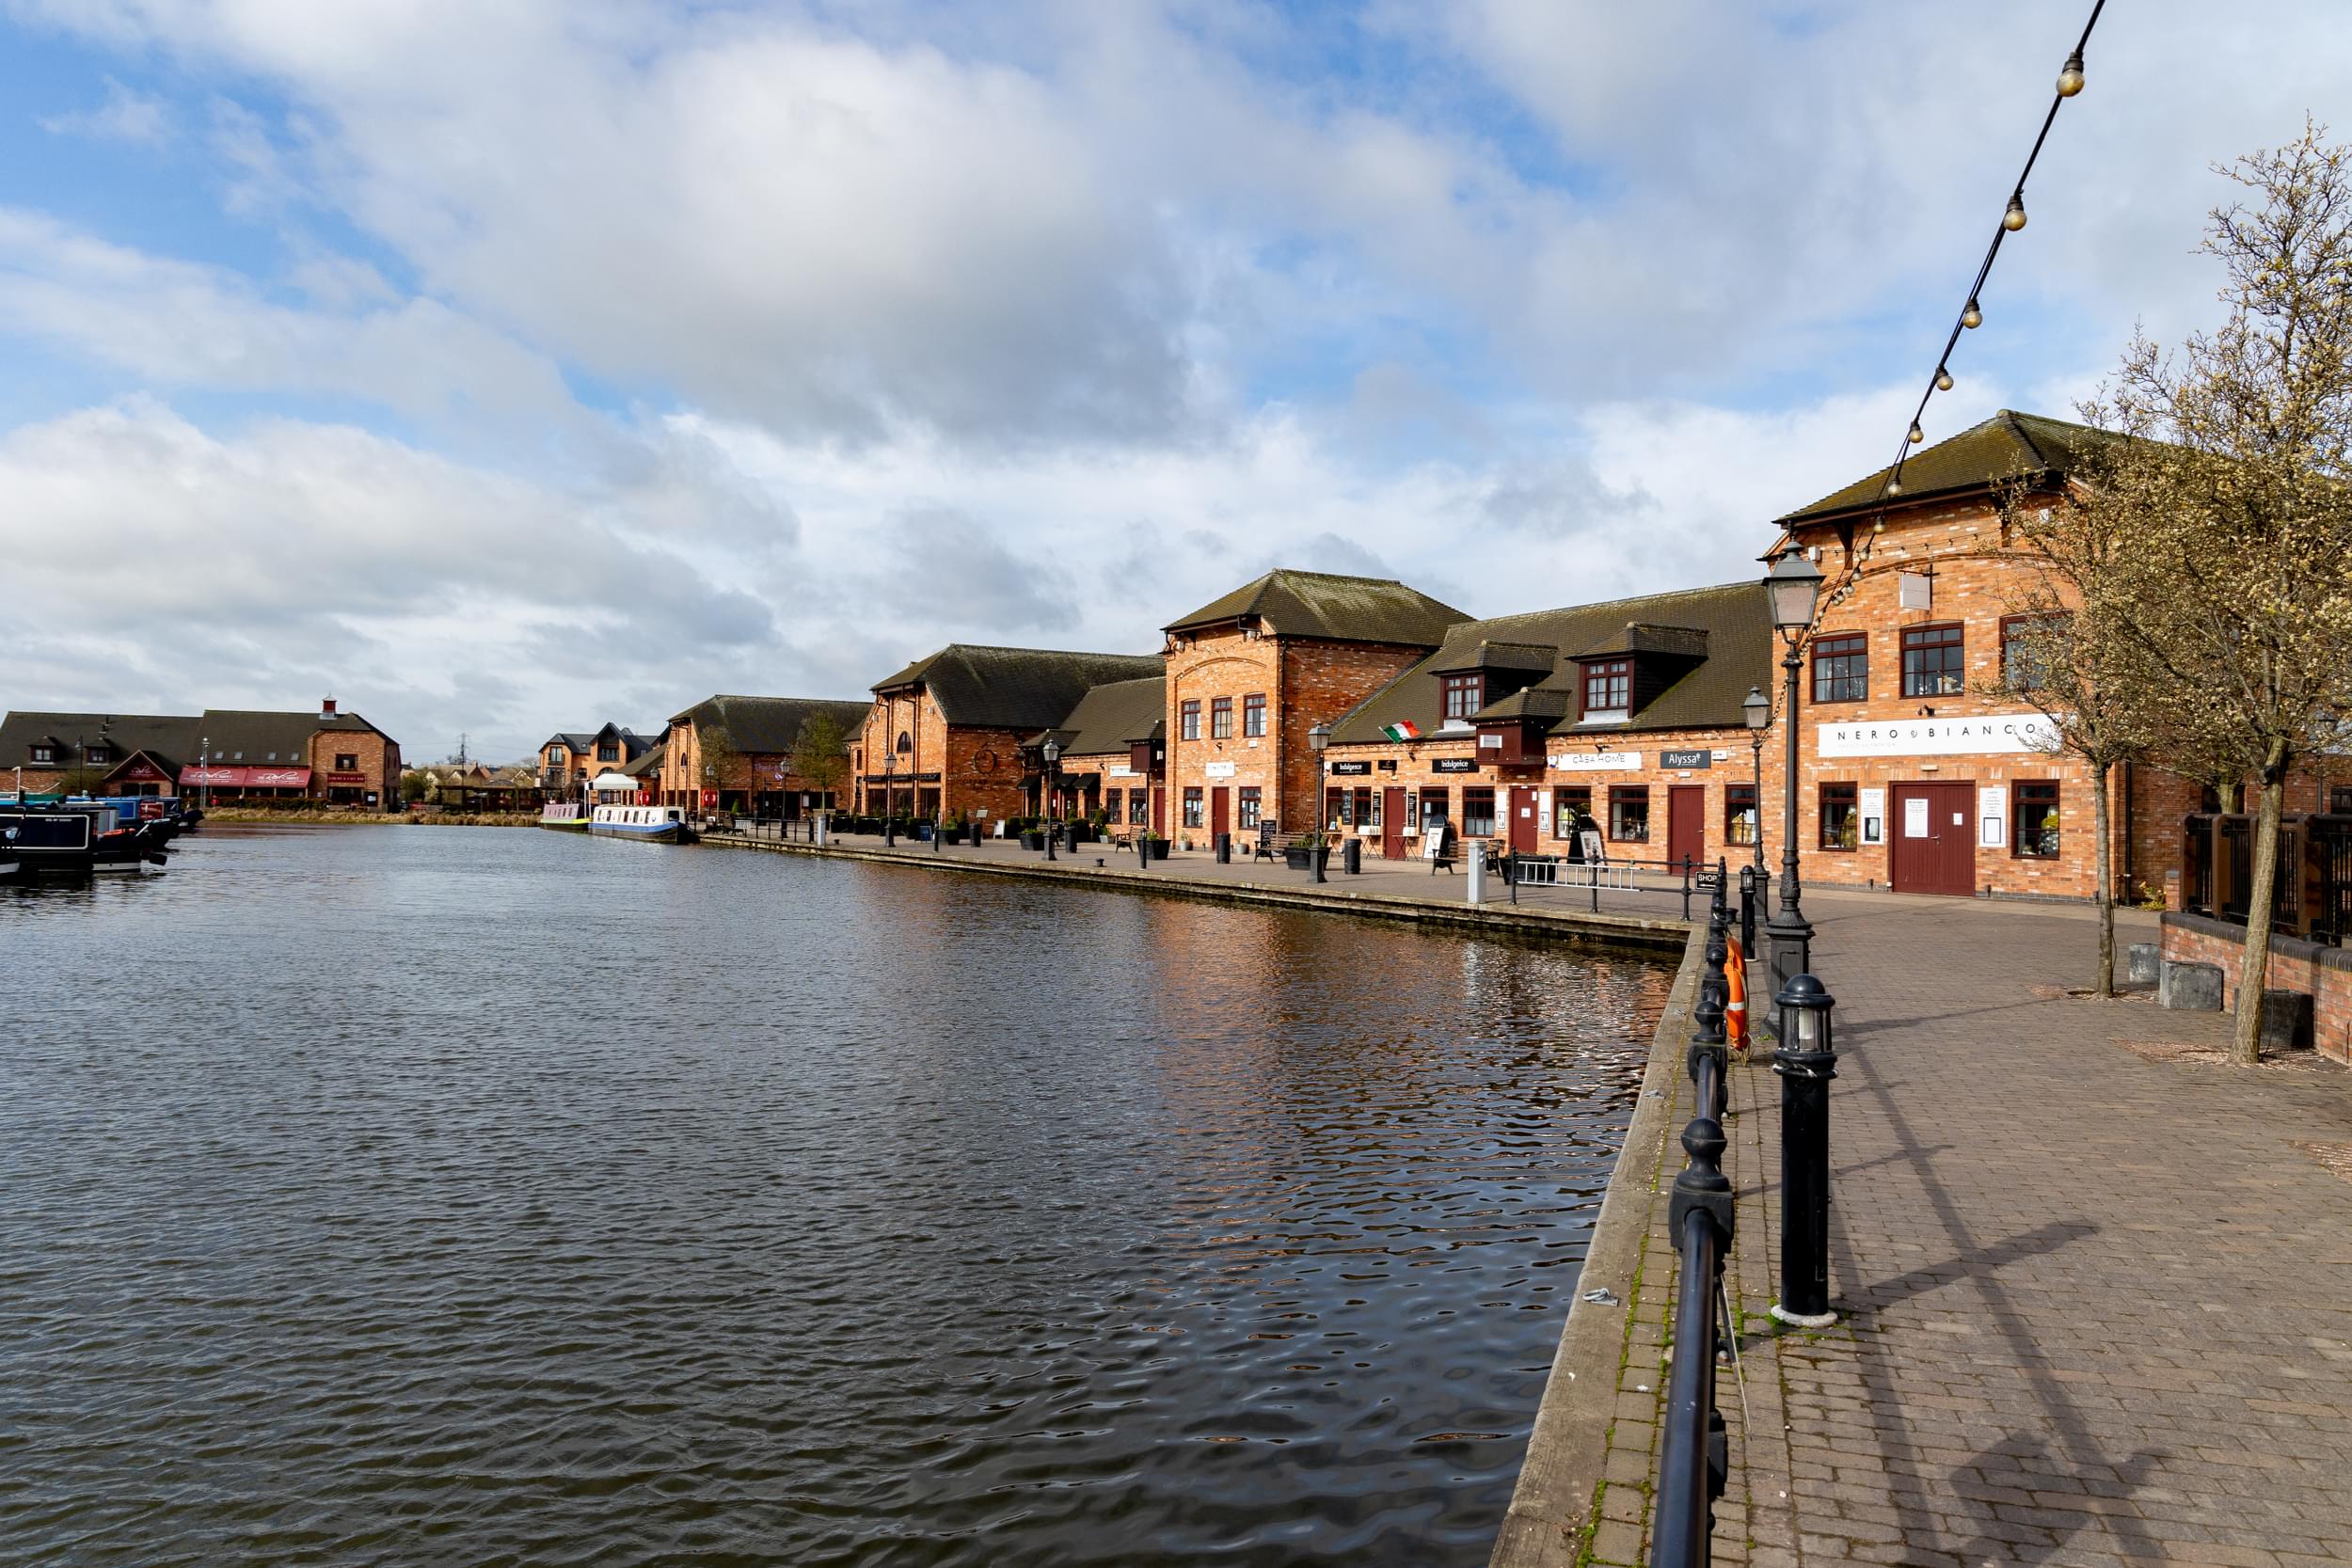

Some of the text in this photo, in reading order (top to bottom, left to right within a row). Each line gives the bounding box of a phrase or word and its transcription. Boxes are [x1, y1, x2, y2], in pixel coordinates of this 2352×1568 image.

[1837, 729, 1899, 740] NERO
[1928, 723, 2036, 737] BIANCO
[1572, 754, 1626, 764] CASA HOME
[1668, 753, 1697, 767] Alyssa
